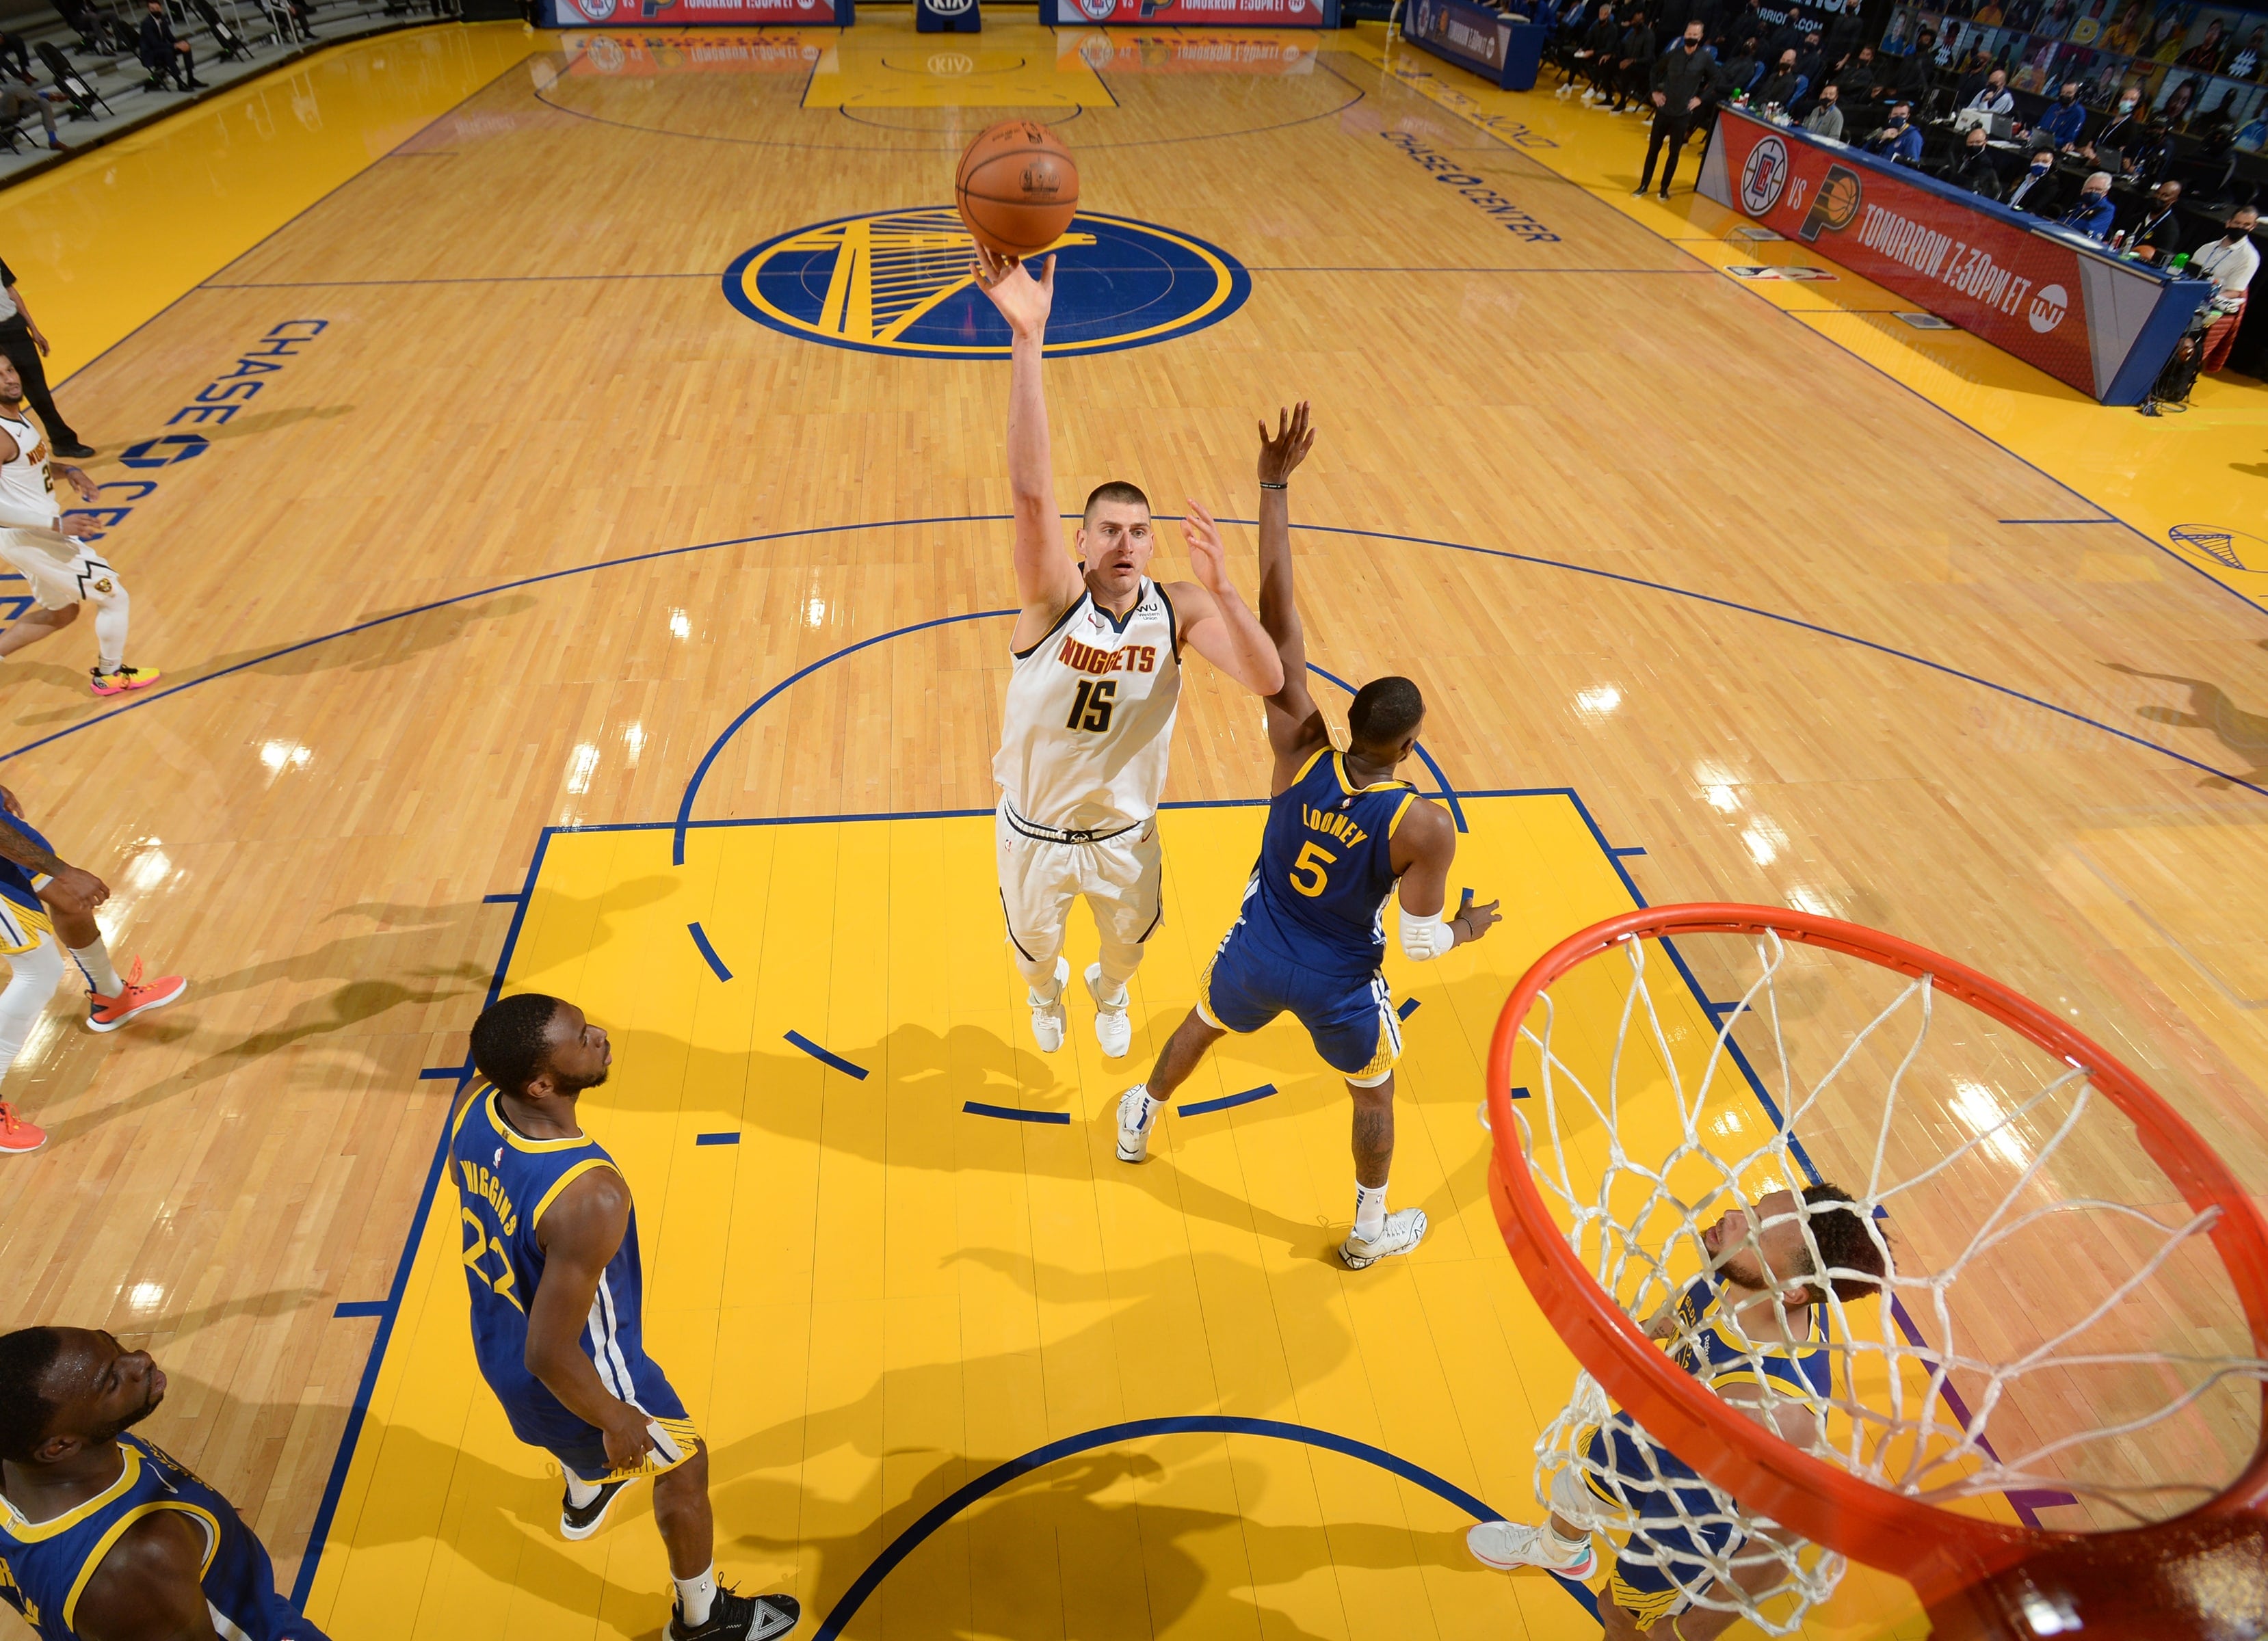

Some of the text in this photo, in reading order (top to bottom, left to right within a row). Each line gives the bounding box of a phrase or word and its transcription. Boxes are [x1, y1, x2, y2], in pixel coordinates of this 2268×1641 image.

[1380, 131, 1562, 242] CHASE CENTER
[1786, 176, 1807, 211] VS
[1857, 204, 1952, 279] TOMORROW
[2001, 275, 2031, 317] ET
[165, 319, 329, 426] CHASE
[1136, 603, 1158, 613] WU
[1058, 634, 1157, 676] NUGGETS
[1065, 678, 1118, 734] 15
[1303, 803, 1368, 849] LOONEY
[1289, 840, 1338, 897] 5
[462, 1207, 525, 1317] 22
